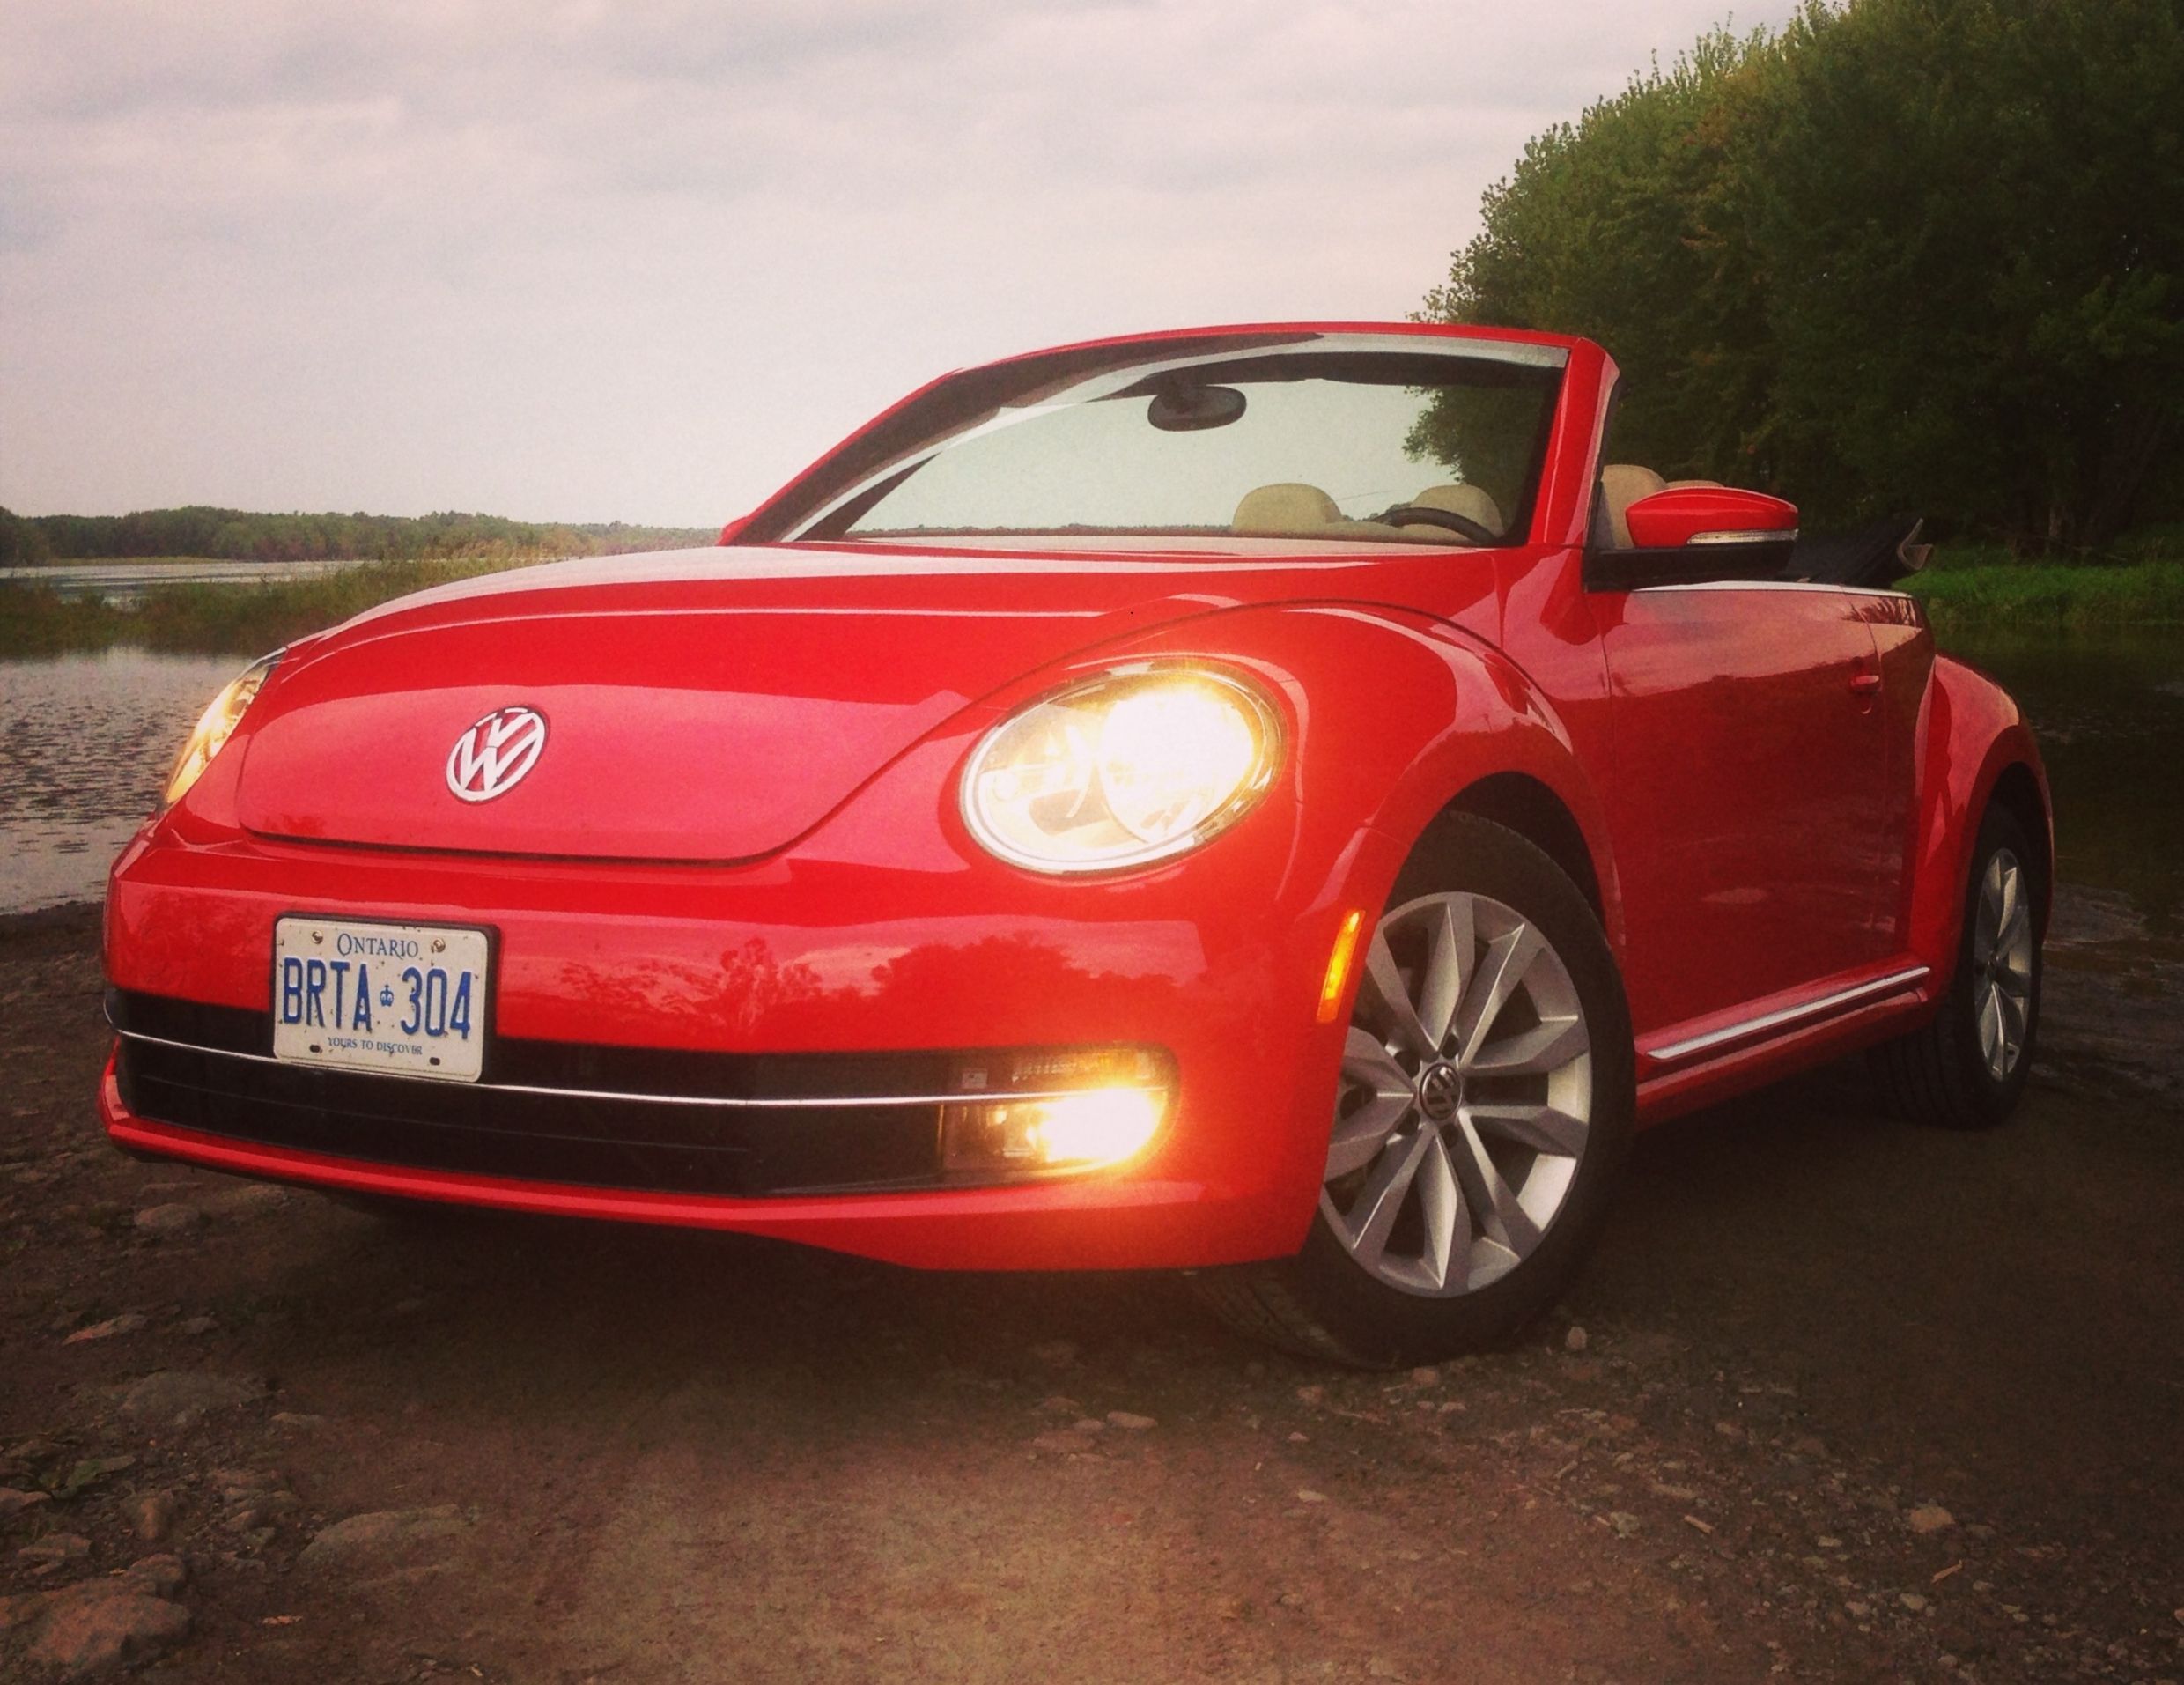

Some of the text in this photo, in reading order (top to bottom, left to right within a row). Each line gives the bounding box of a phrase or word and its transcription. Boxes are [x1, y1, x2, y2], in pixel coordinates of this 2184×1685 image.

[446, 706, 546, 802] VW
[336, 933, 419, 959] ONTARIO
[283, 957, 472, 1040] BRTA 304
[328, 1037, 423, 1055] YOURS TO DISCOVER
